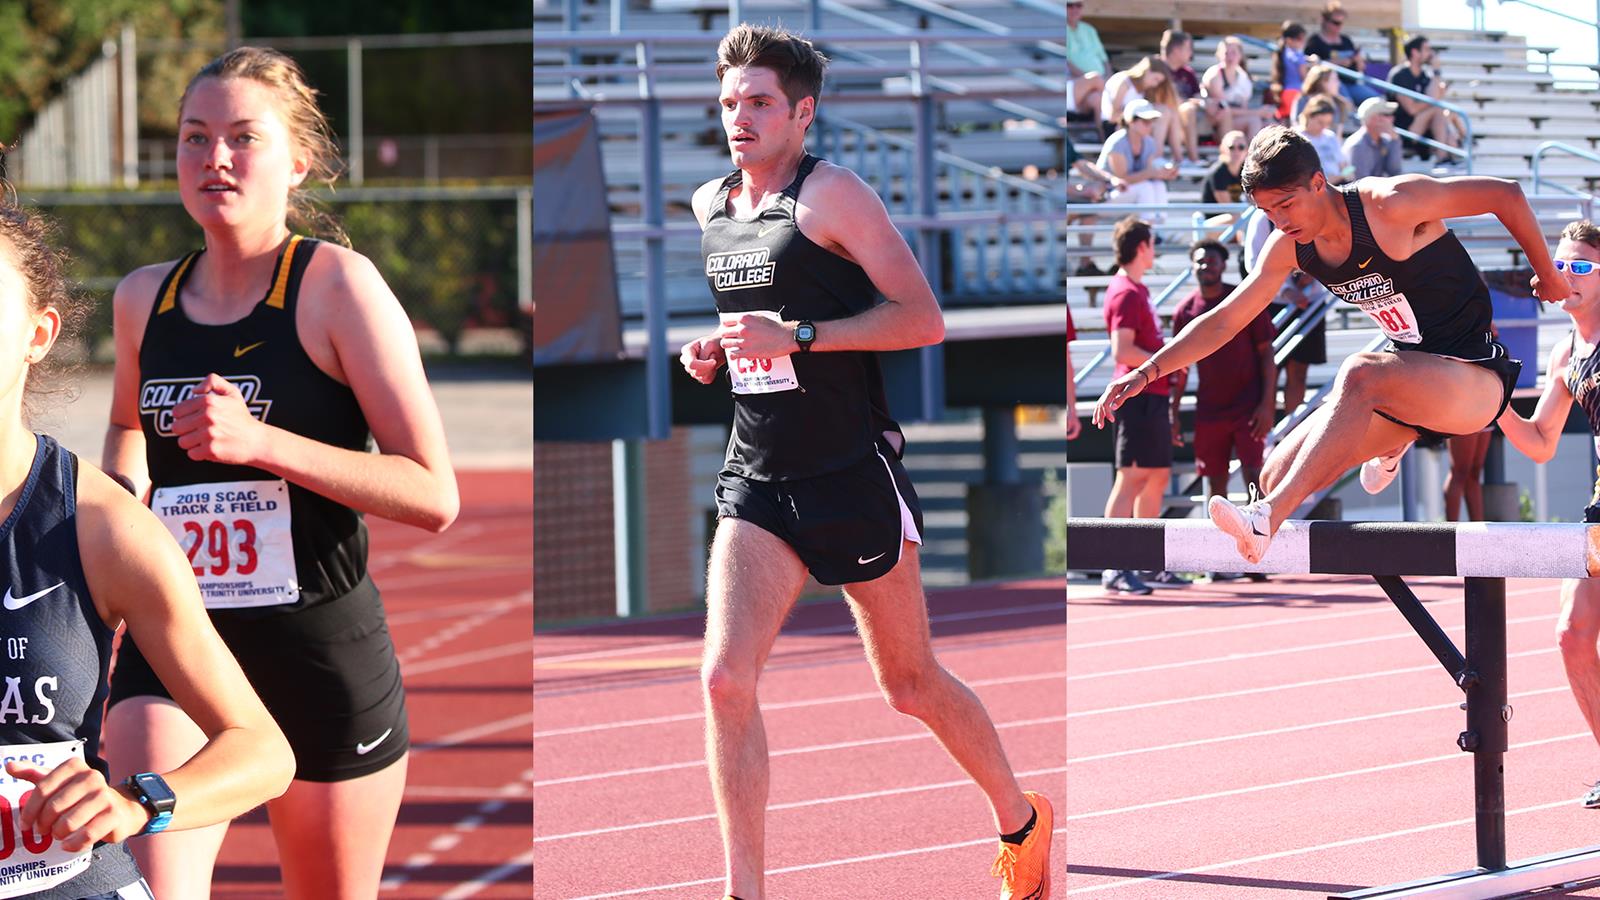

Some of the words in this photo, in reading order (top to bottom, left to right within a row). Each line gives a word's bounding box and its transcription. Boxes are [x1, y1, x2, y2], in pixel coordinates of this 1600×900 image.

[707, 251, 767, 273] COLORADO
[717, 266, 772, 288] COLLEGE
[1332, 275, 1381, 295] COLORADO
[1345, 282, 1391, 302] COLLEGE
[1371, 306, 1411, 332] 81
[142, 382, 255, 408] COLOO
[176, 491, 210, 505] 2019
[215, 490, 258, 503] SCAC
[161, 503, 210, 517] TRACK
[213, 502, 225, 514] &
[231, 500, 277, 514] FIELD
[183, 519, 258, 577] 293
[199, 581, 253, 590] AMPIONSHIPS
[206, 589, 235, 598] TRINITY
[238, 586, 285, 597] UNIVERSITY
[7, 637, 29, 659] OF
[0, 860, 47, 878] ONSHIPS
